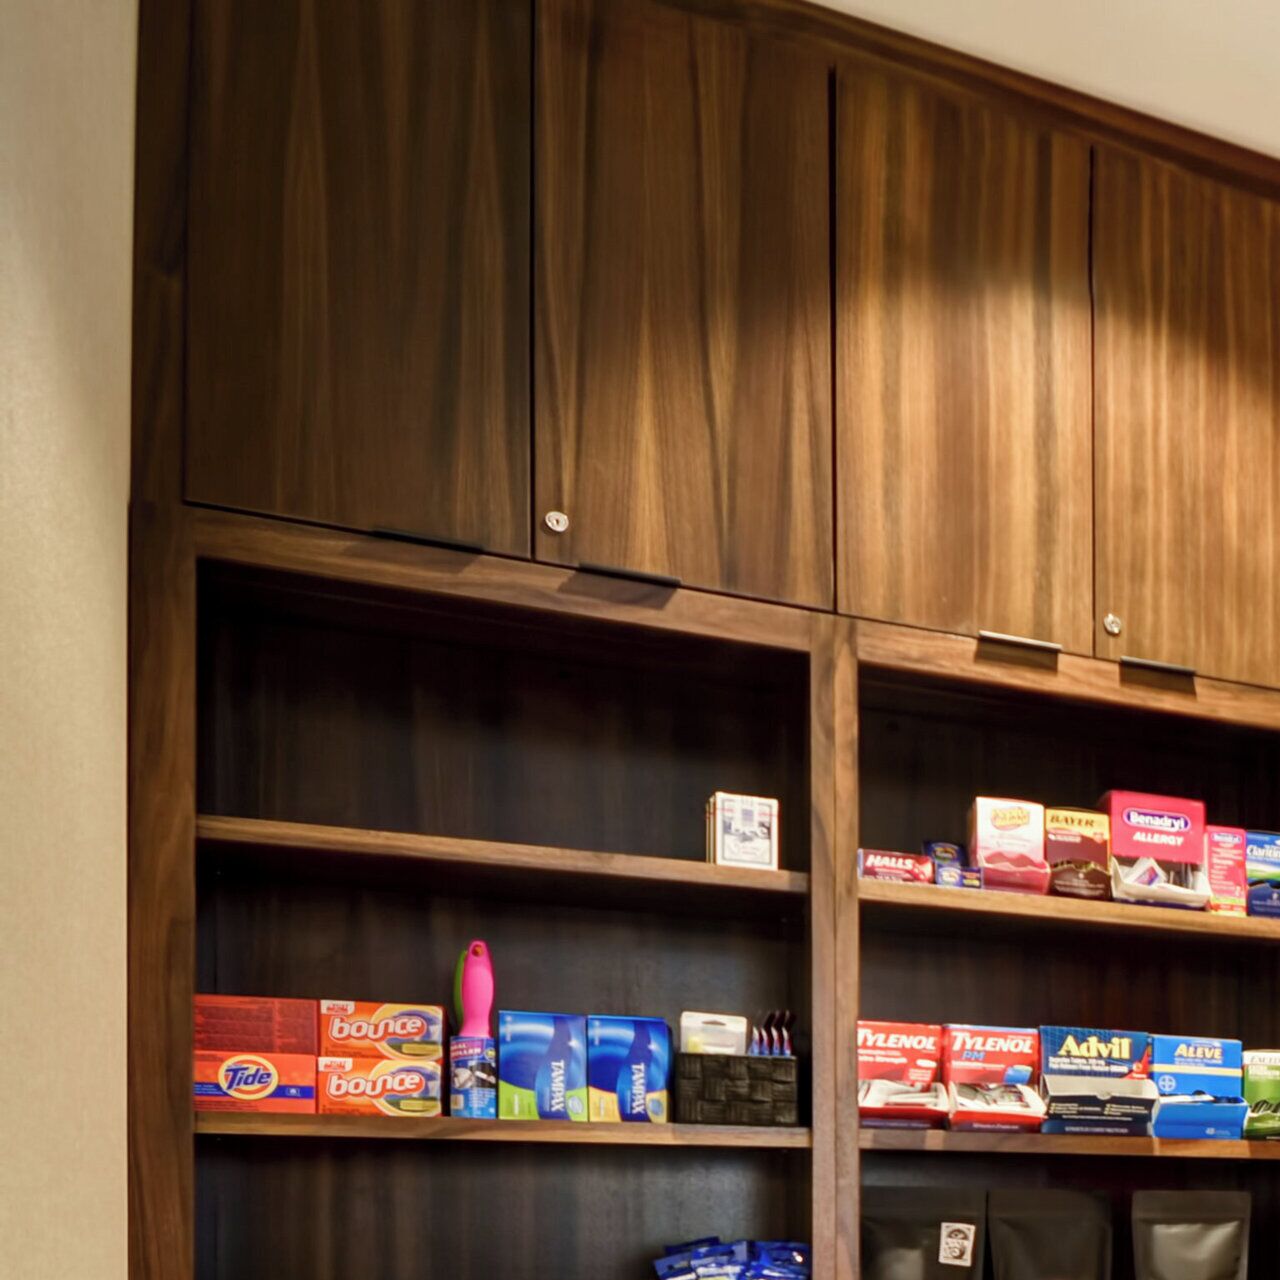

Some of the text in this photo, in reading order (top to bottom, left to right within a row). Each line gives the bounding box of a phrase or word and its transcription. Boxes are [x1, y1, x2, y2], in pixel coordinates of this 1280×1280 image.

[1050, 813, 1095, 827] BAYER
[1129, 811, 1185, 832] Benadryl
[1133, 831, 1184, 846] ALLERGY
[865, 854, 914, 870] HALLS
[331, 1015, 424, 1040] bounce
[858, 1028, 937, 1050] TYLENOL
[951, 1031, 1034, 1054] TYLENOL
[1058, 1034, 1132, 1060] Advil
[961, 1050, 986, 1061] PM
[1174, 1043, 1222, 1060] ALEVE
[225, 1065, 272, 1091] Tide
[330, 1072, 420, 1097] bounce
[551, 1059, 565, 1112] TAMPAX
[631, 1062, 645, 1114] TAMPAX
